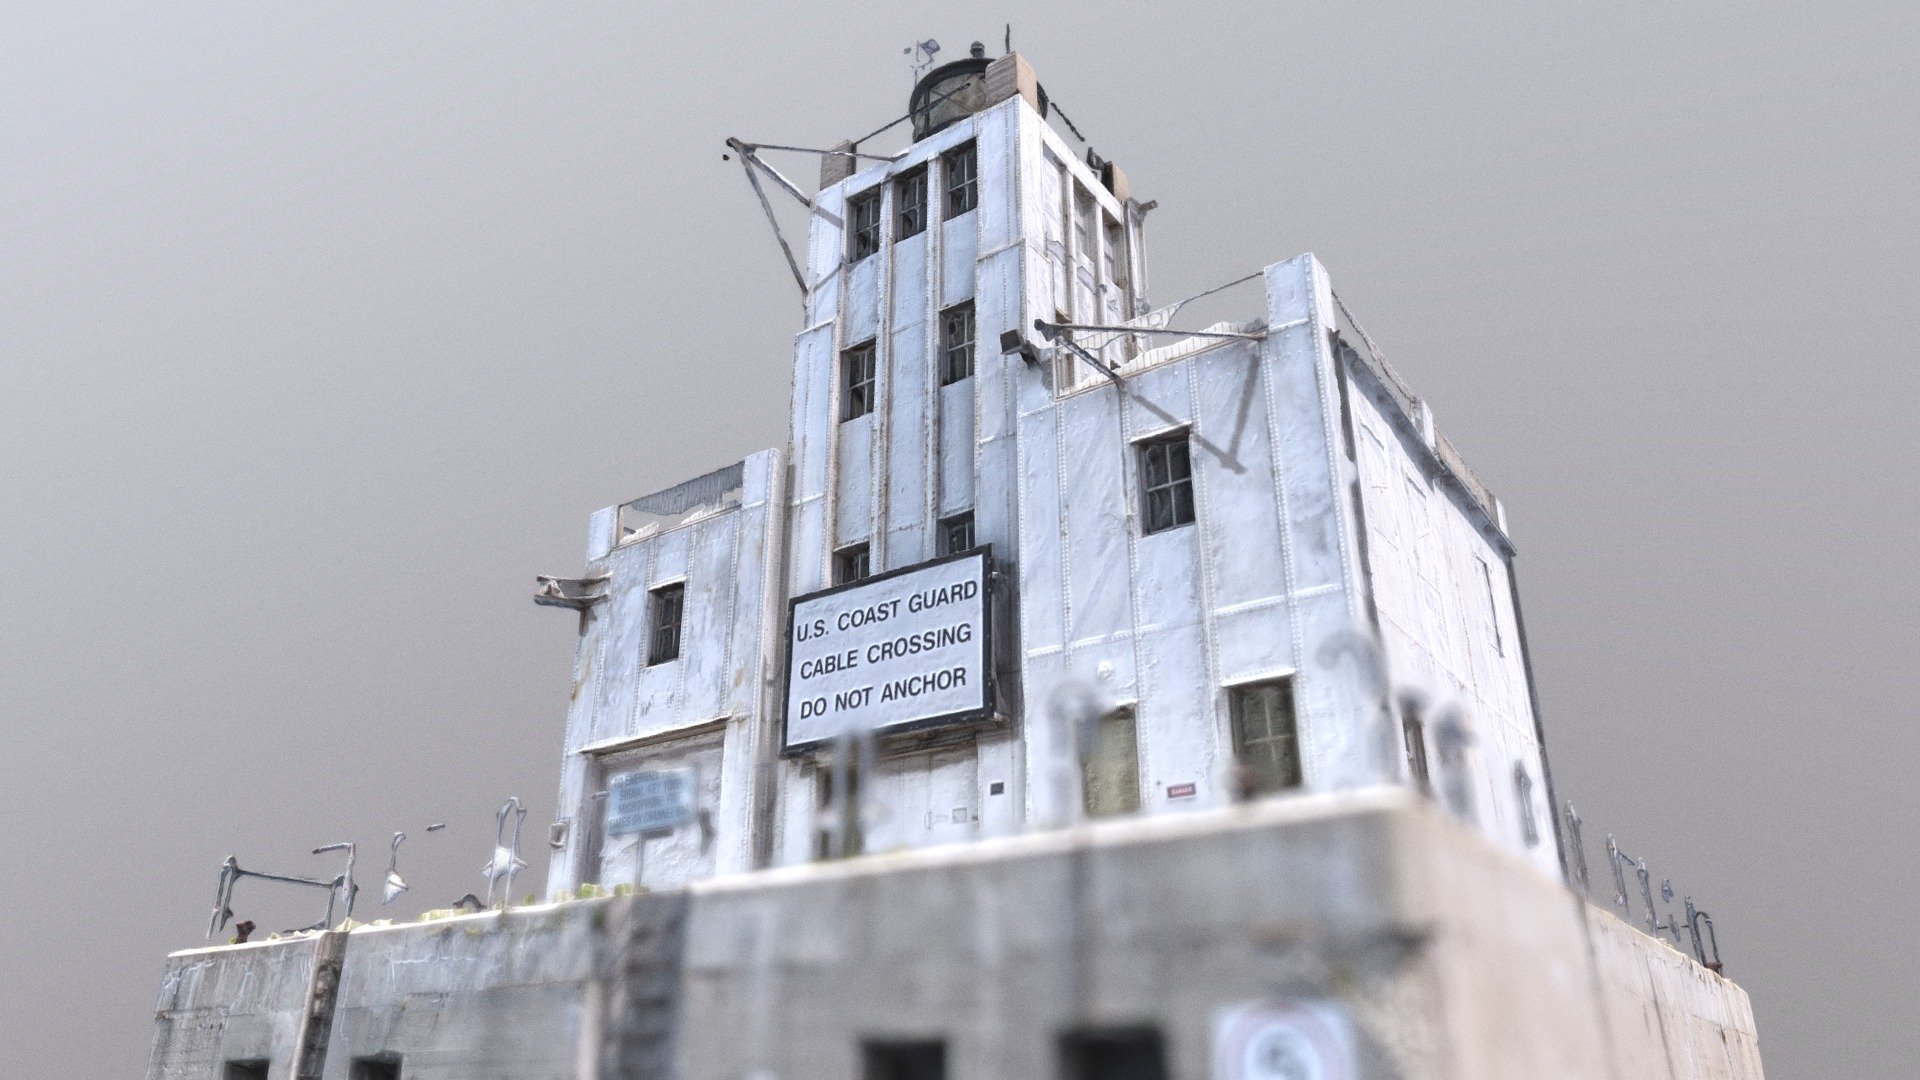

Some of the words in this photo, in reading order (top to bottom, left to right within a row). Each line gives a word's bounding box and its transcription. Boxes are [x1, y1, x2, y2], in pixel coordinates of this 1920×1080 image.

[797, 619, 830, 643] U.S.
[837, 599, 901, 632] COAST
[908, 580, 978, 614] GUARD
[800, 649, 859, 680] CABLE
[867, 623, 972, 664] CROSSING
[800, 697, 827, 720] DO
[835, 686, 875, 712] NOT
[881, 667, 966, 703] ANCHOR
